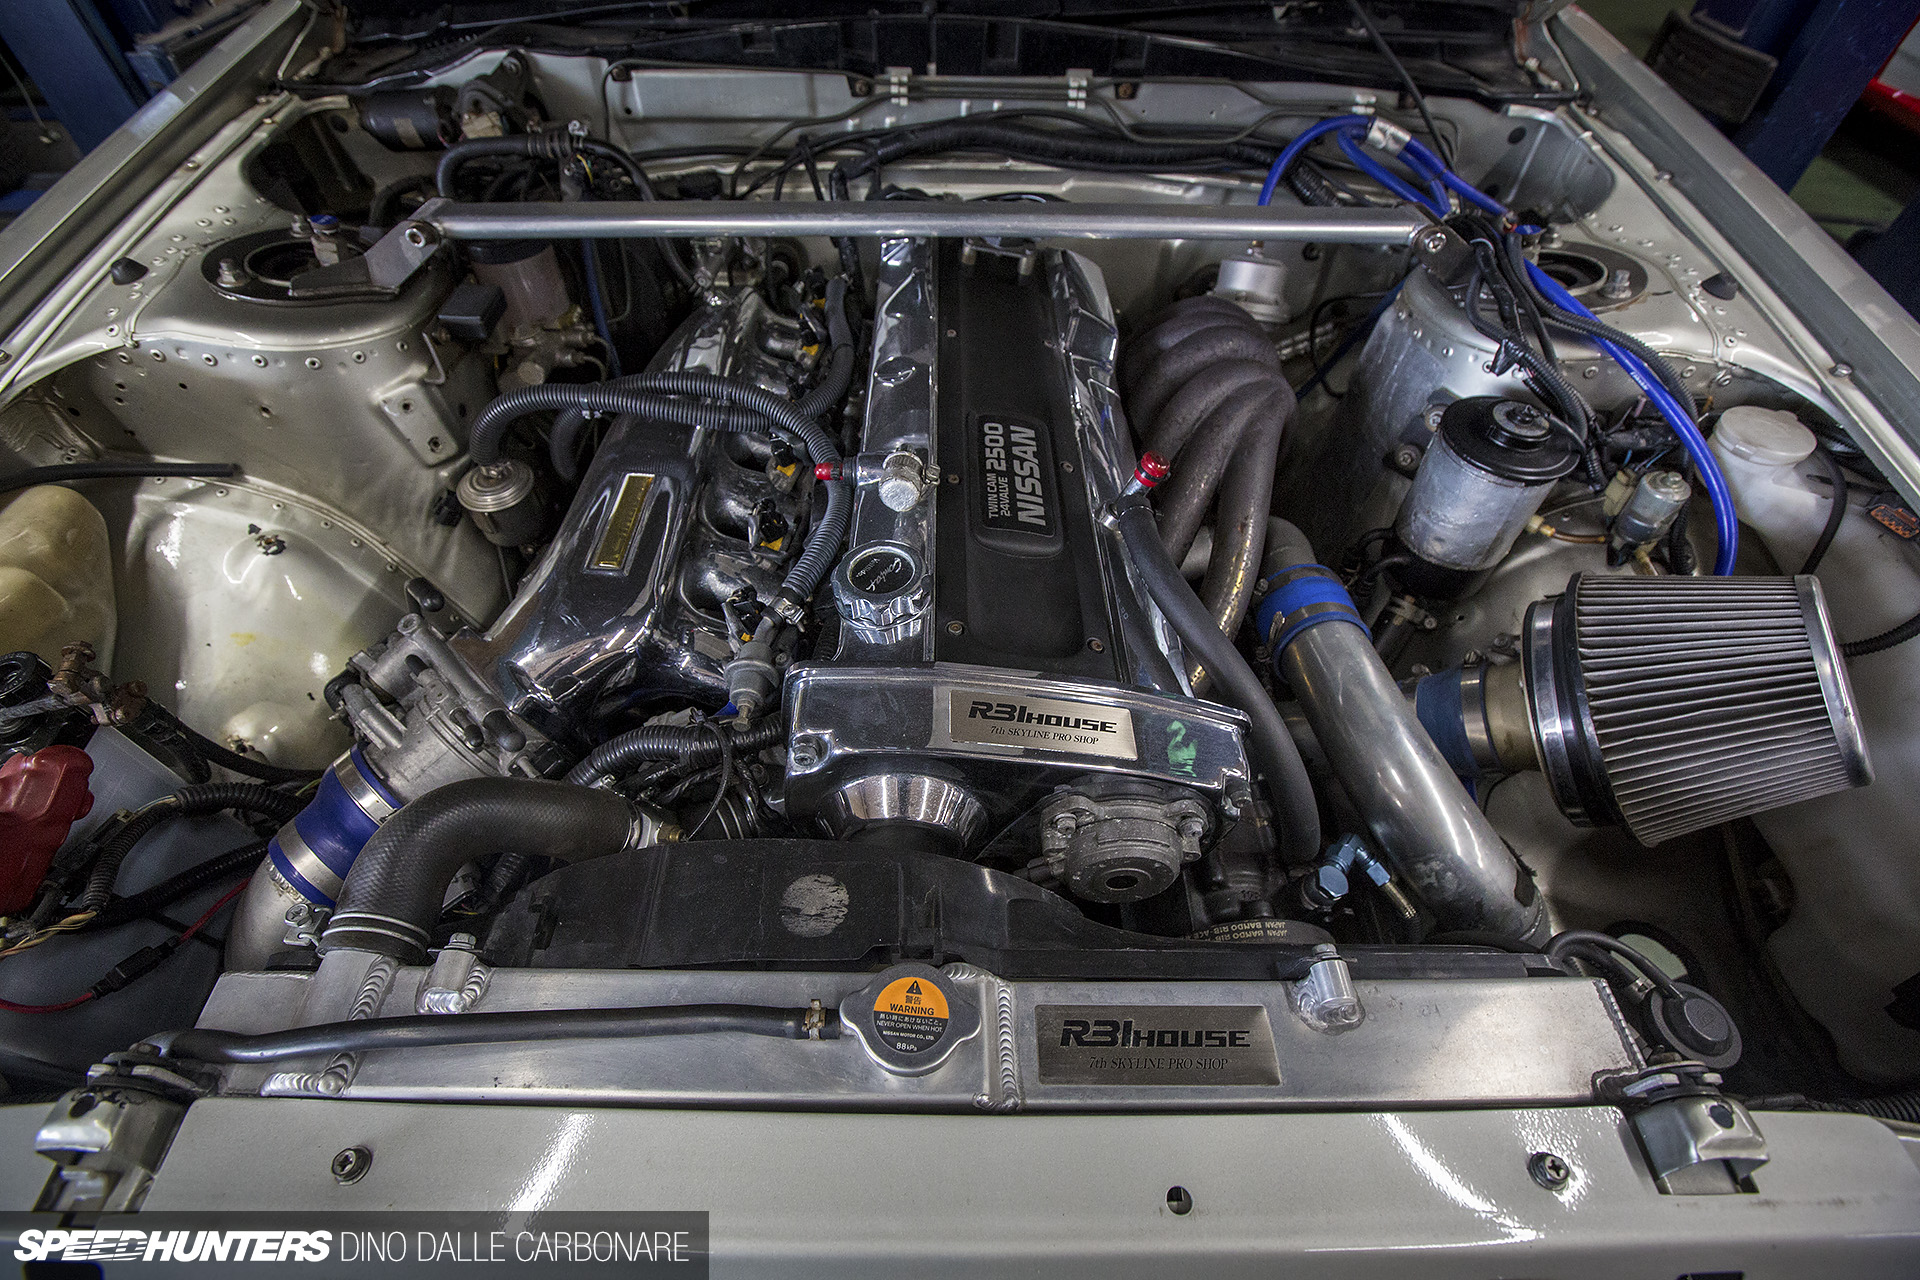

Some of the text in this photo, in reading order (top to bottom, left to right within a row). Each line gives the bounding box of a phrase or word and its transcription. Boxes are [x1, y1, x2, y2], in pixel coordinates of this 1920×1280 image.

[983, 422, 1007, 472] 2500
[1009, 425, 1046, 526] NISSAN
[986, 473, 999, 519] TWIN CAM
[990, 725, 1099, 745] 7th SKYLINE PRO SHOP
[1232, 921, 1262, 931] BANDO
[905, 994, 922, 1005] 警告
[889, 1003, 935, 1016] WARNING
[876, 1020, 895, 1028] NEVER
[895, 1022, 912, 1030] OPEN
[1088, 1056, 1229, 1070] 7th SKYLINE PRO SHOP
